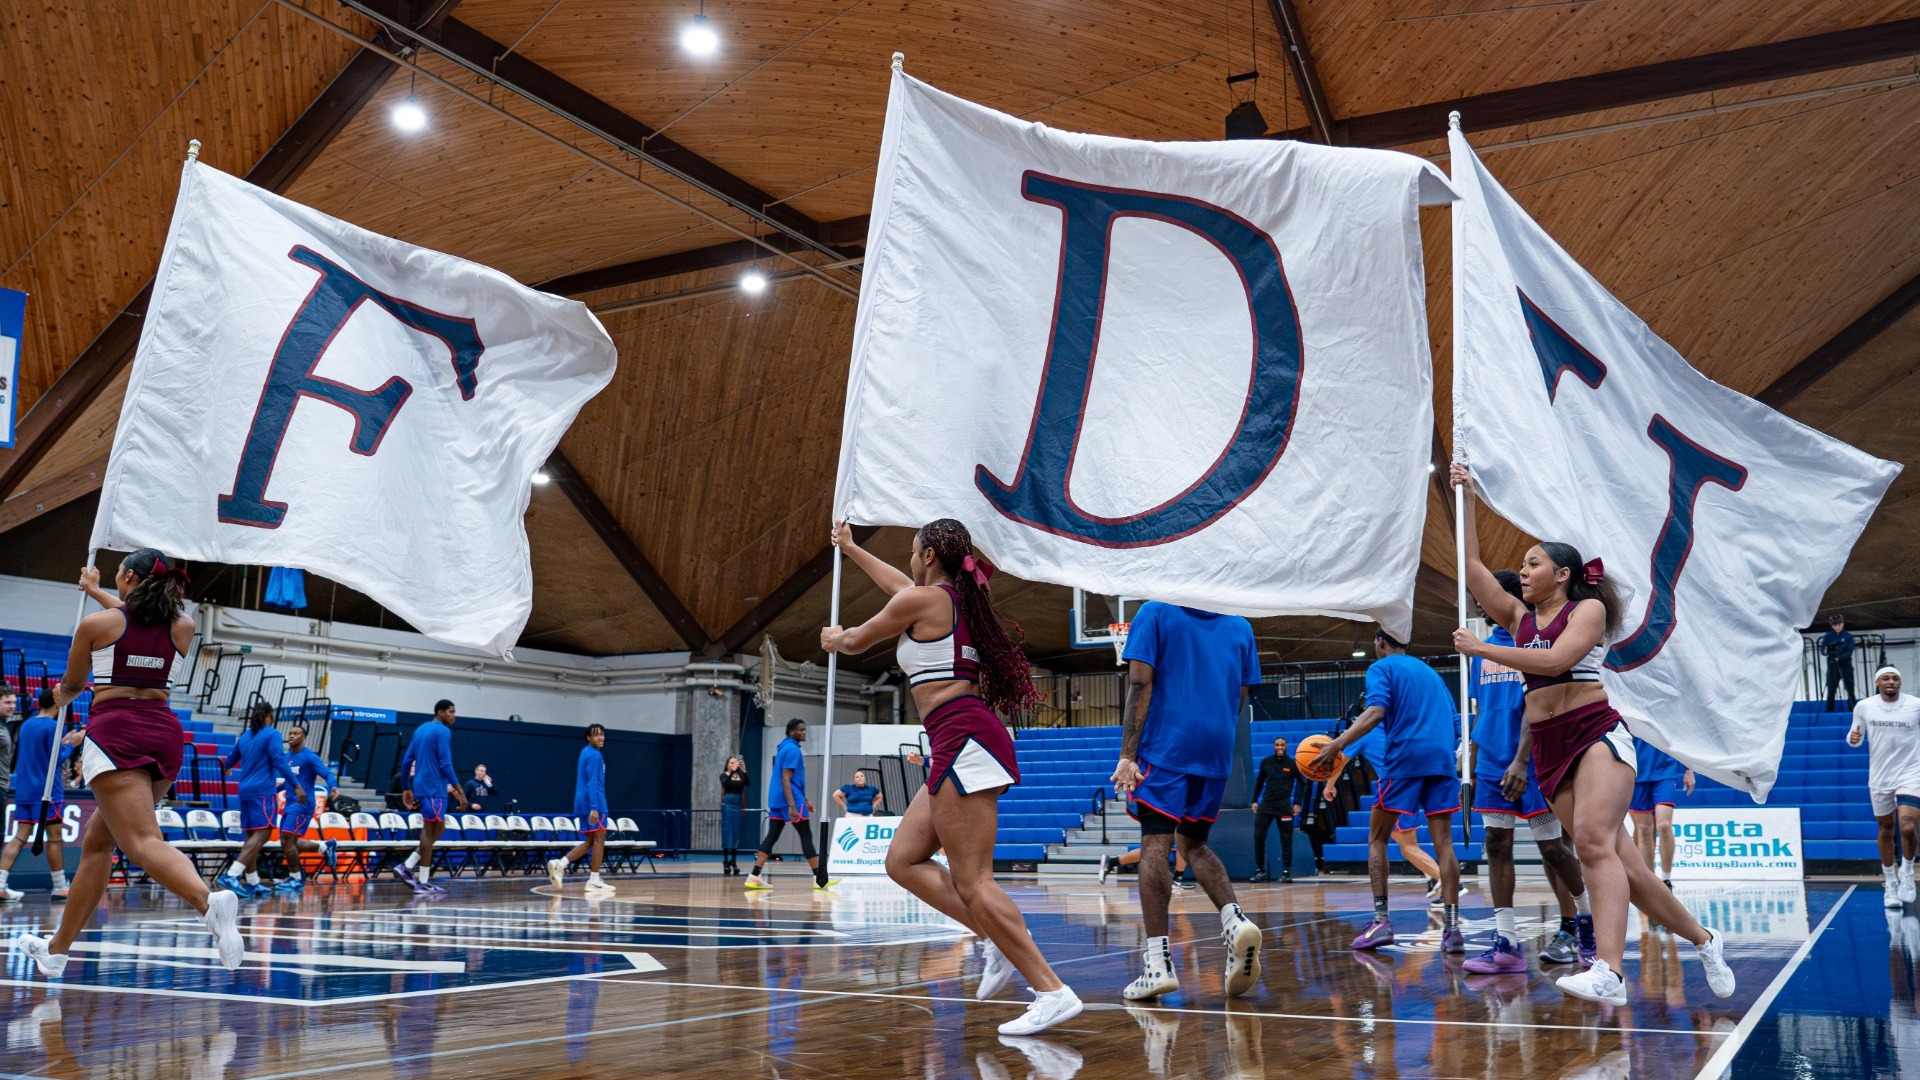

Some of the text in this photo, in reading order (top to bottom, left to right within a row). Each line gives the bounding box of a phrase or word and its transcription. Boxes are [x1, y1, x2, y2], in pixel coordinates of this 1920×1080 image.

[975, 170, 1305, 549] D
[217, 244, 485, 530] F
[127, 655, 165, 669] KNIGHTS
[1656, 820, 1763, 842] ogota
[863, 842, 890, 854] Savin
[1706, 838, 1793, 857] Bank
